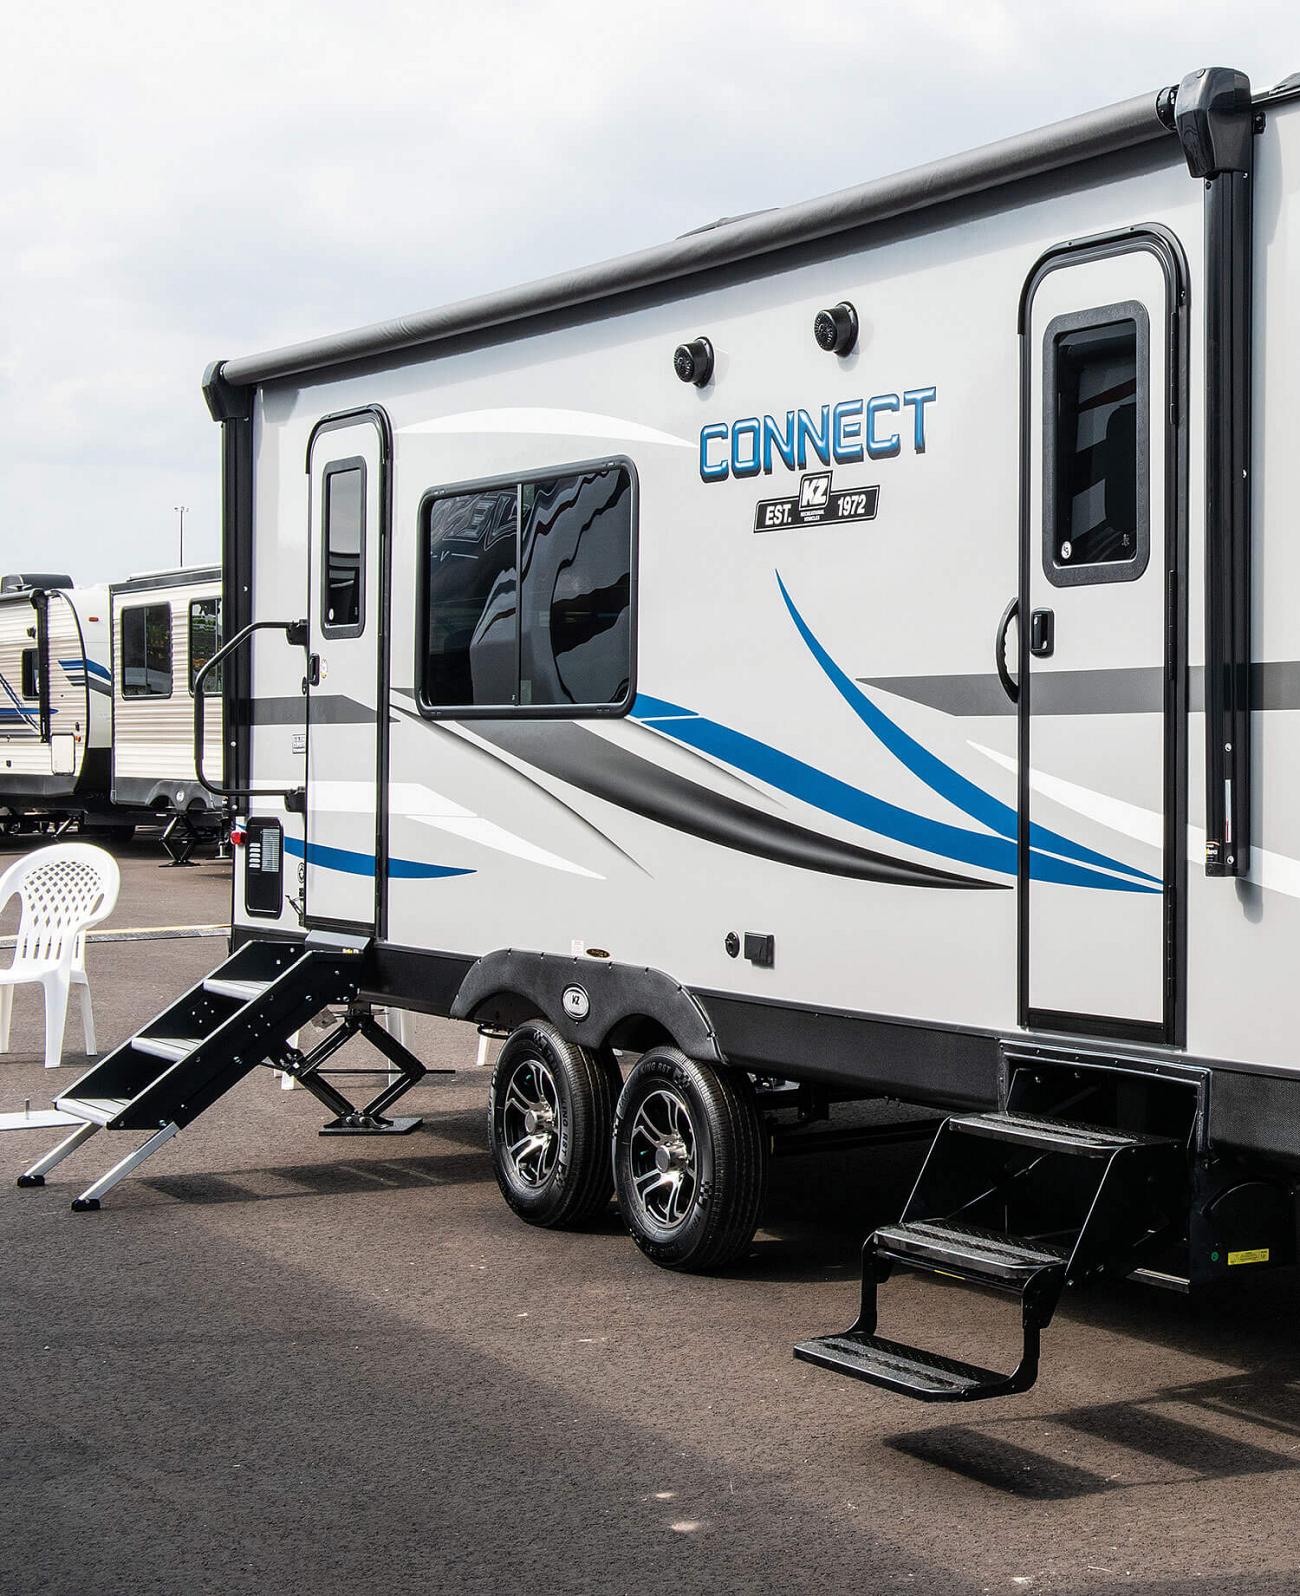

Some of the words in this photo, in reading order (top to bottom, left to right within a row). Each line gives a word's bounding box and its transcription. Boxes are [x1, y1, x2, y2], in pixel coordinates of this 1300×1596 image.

[699, 386, 937, 484] CONNECT
[765, 503, 792, 526] EST.
[801, 477, 829, 507] KZ
[837, 494, 867, 517] 1972
[657, 1062, 672, 1074] RST
